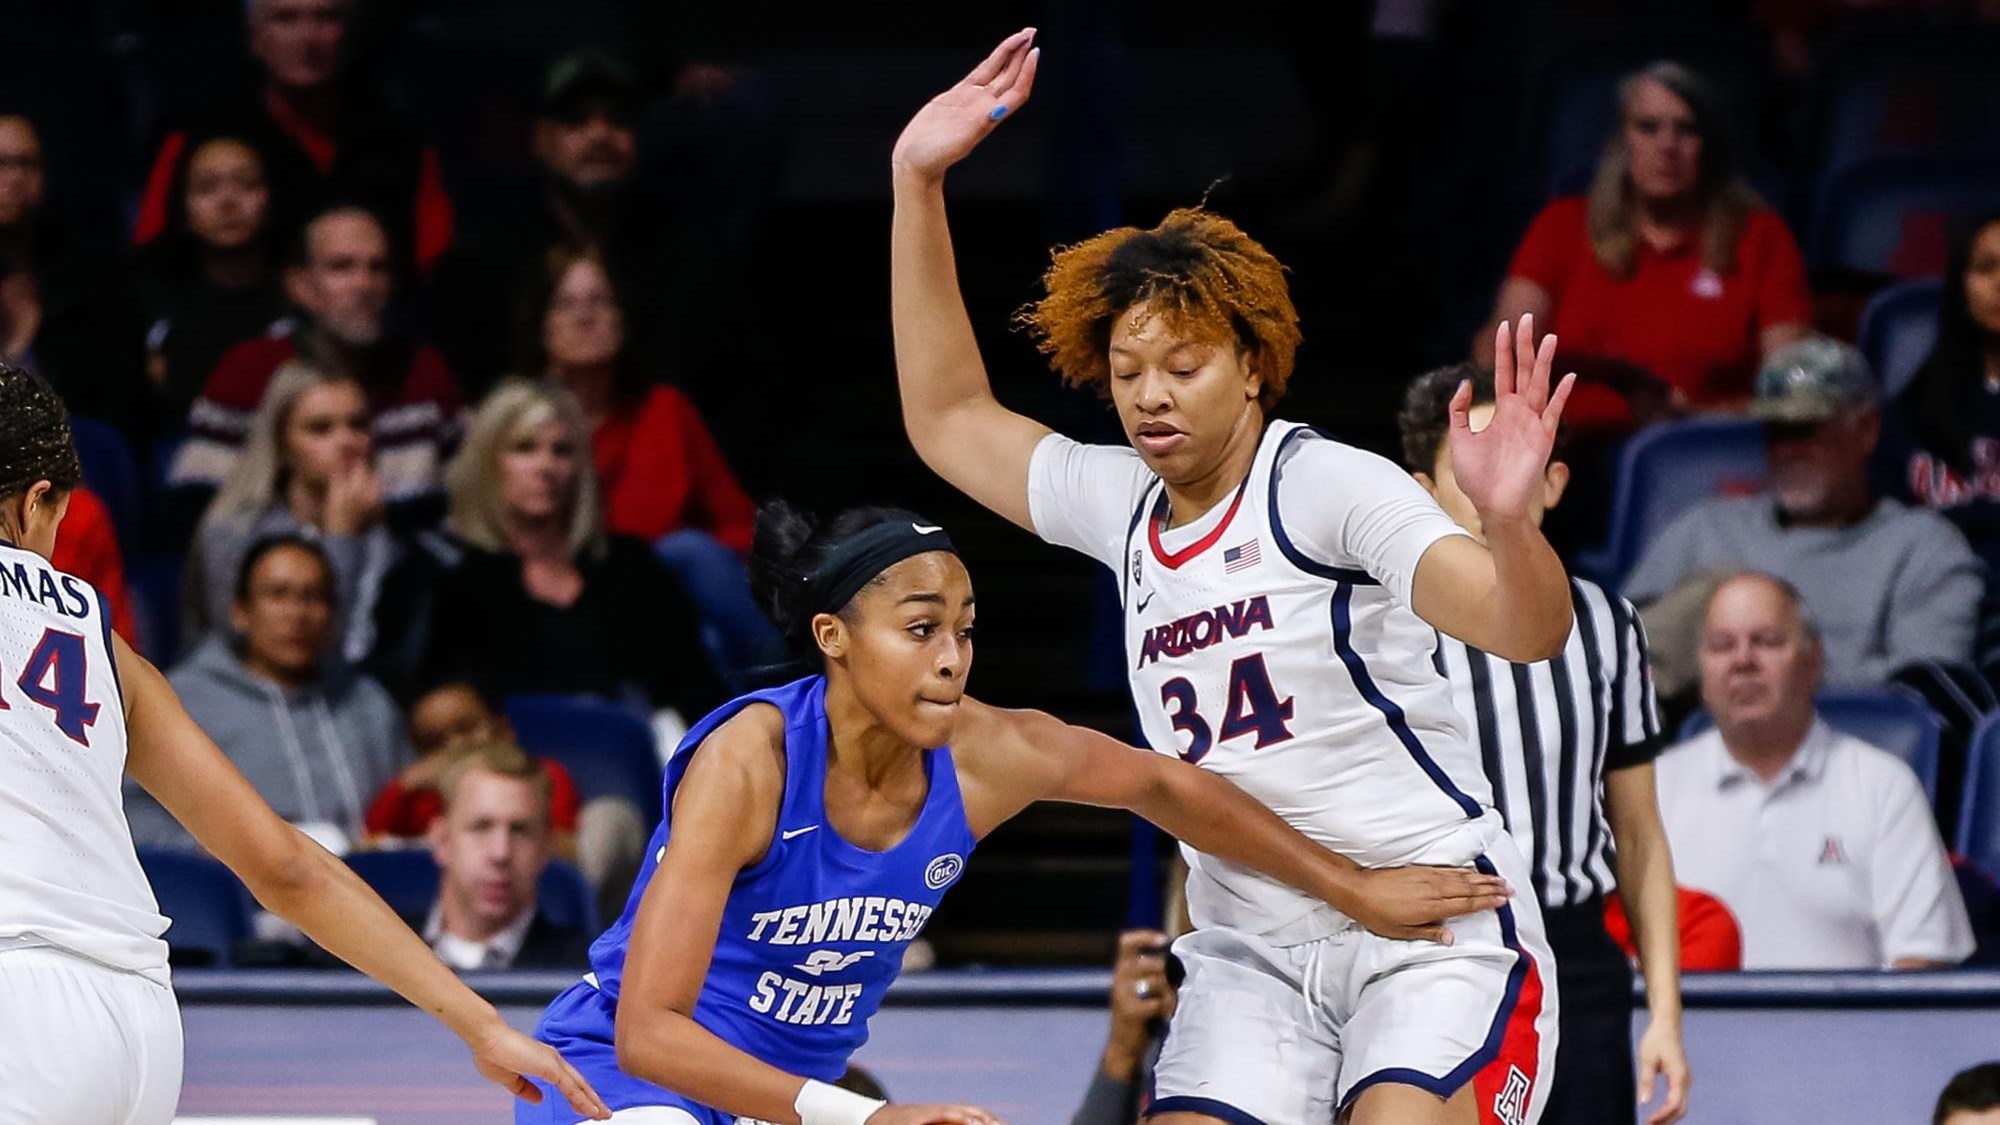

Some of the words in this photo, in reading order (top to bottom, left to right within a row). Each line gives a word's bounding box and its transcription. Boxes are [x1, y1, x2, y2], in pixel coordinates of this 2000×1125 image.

[1137, 594, 1275, 671] ARIZONA
[0, 627, 101, 748] 4
[1160, 652, 1295, 766] 34
[748, 970, 862, 1025] STATE
[1493, 1063, 1531, 1125] A
